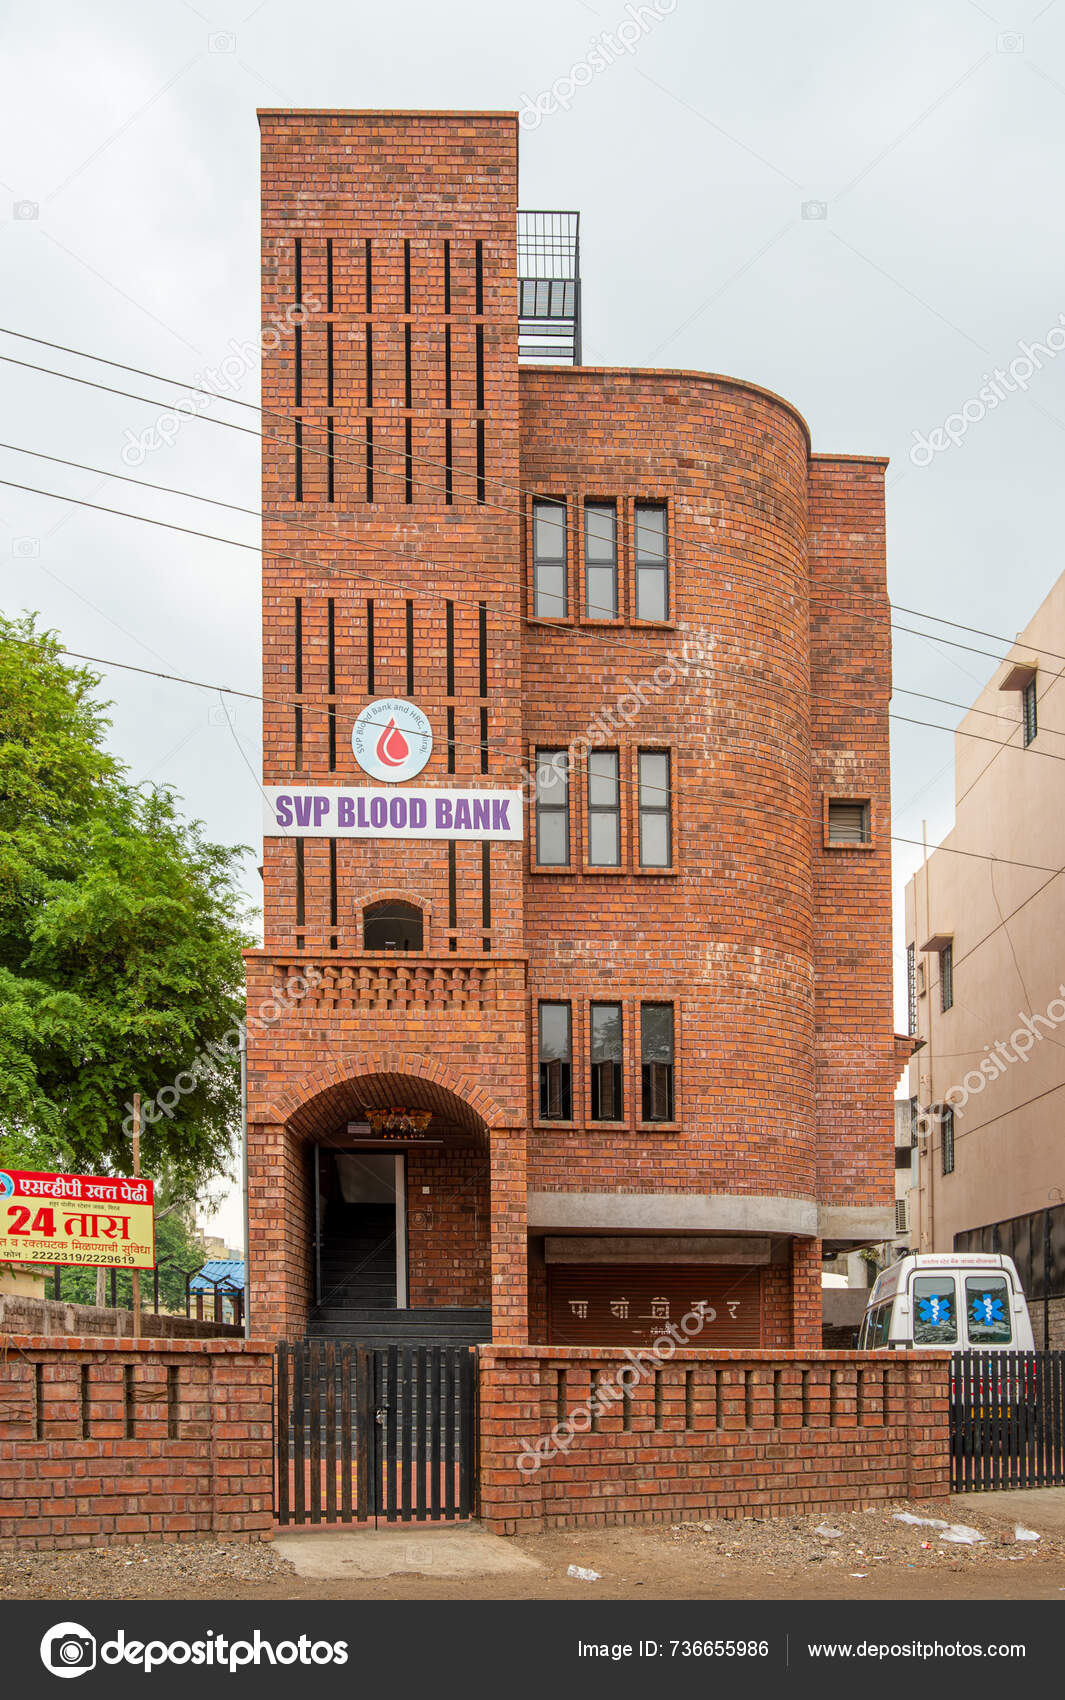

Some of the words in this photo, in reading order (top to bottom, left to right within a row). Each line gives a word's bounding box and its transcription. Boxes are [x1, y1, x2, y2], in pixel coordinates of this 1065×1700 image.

[372, 703, 393, 715] Bank
[394, 704, 410, 714] and
[357, 712, 373, 735] Blood
[355, 738, 365, 754] SVP
[276, 795, 330, 827] SVP
[337, 796, 427, 829] BLOOD
[435, 798, 512, 831] BANK
[19, 1177, 82, 1198] एसव्हीपी
[85, 1184, 117, 1200] रक्त
[120, 1182, 148, 1202] पेढी
[7, 1205, 57, 1237] 24
[62, 1212, 131, 1240] तास
[11, 1239, 18, 1247] व
[22, 1239, 68, 1251] रक्तघटक
[72, 1239, 118, 1254] मिळण्याची
[121, 1242, 151, 1257] सुविधा
[3, 1250, 21, 1259] फोन
[31, 1251, 135, 1265] 2222319/2229619
